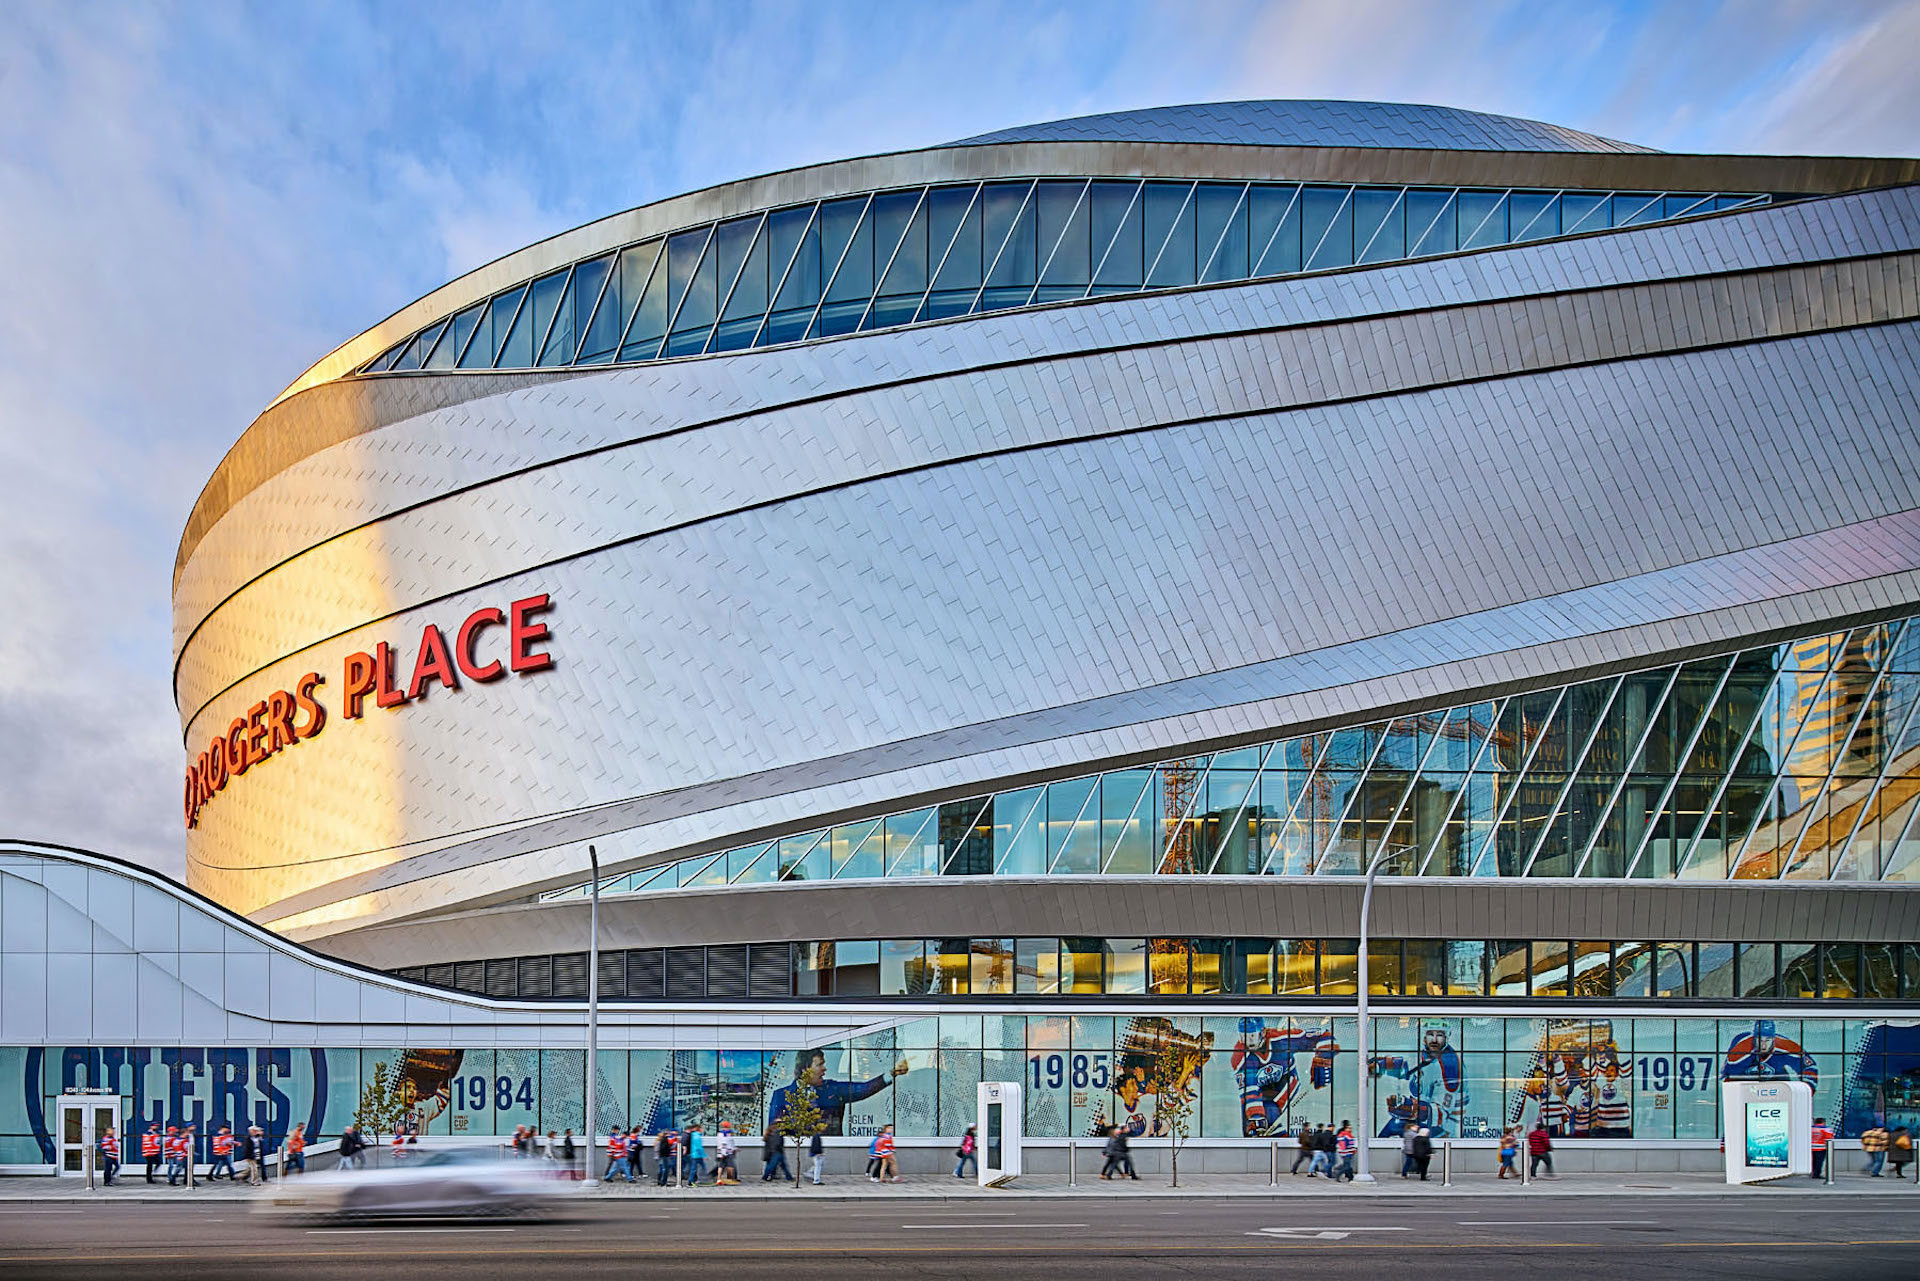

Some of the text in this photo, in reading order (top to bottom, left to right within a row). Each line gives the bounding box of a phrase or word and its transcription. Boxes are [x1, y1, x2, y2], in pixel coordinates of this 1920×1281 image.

[197, 593, 554, 807] ROGERS PLACE
[1030, 1055, 1108, 1089] 1985
[1638, 1057, 1713, 1091] 1987
[454, 1076, 534, 1110] 1984
[1073, 1096, 1088, 1104] CUP
[454, 1120, 469, 1128] CUP
[852, 1115, 874, 1124] GLEN
[1463, 1129, 1502, 1138] ANDERSON
